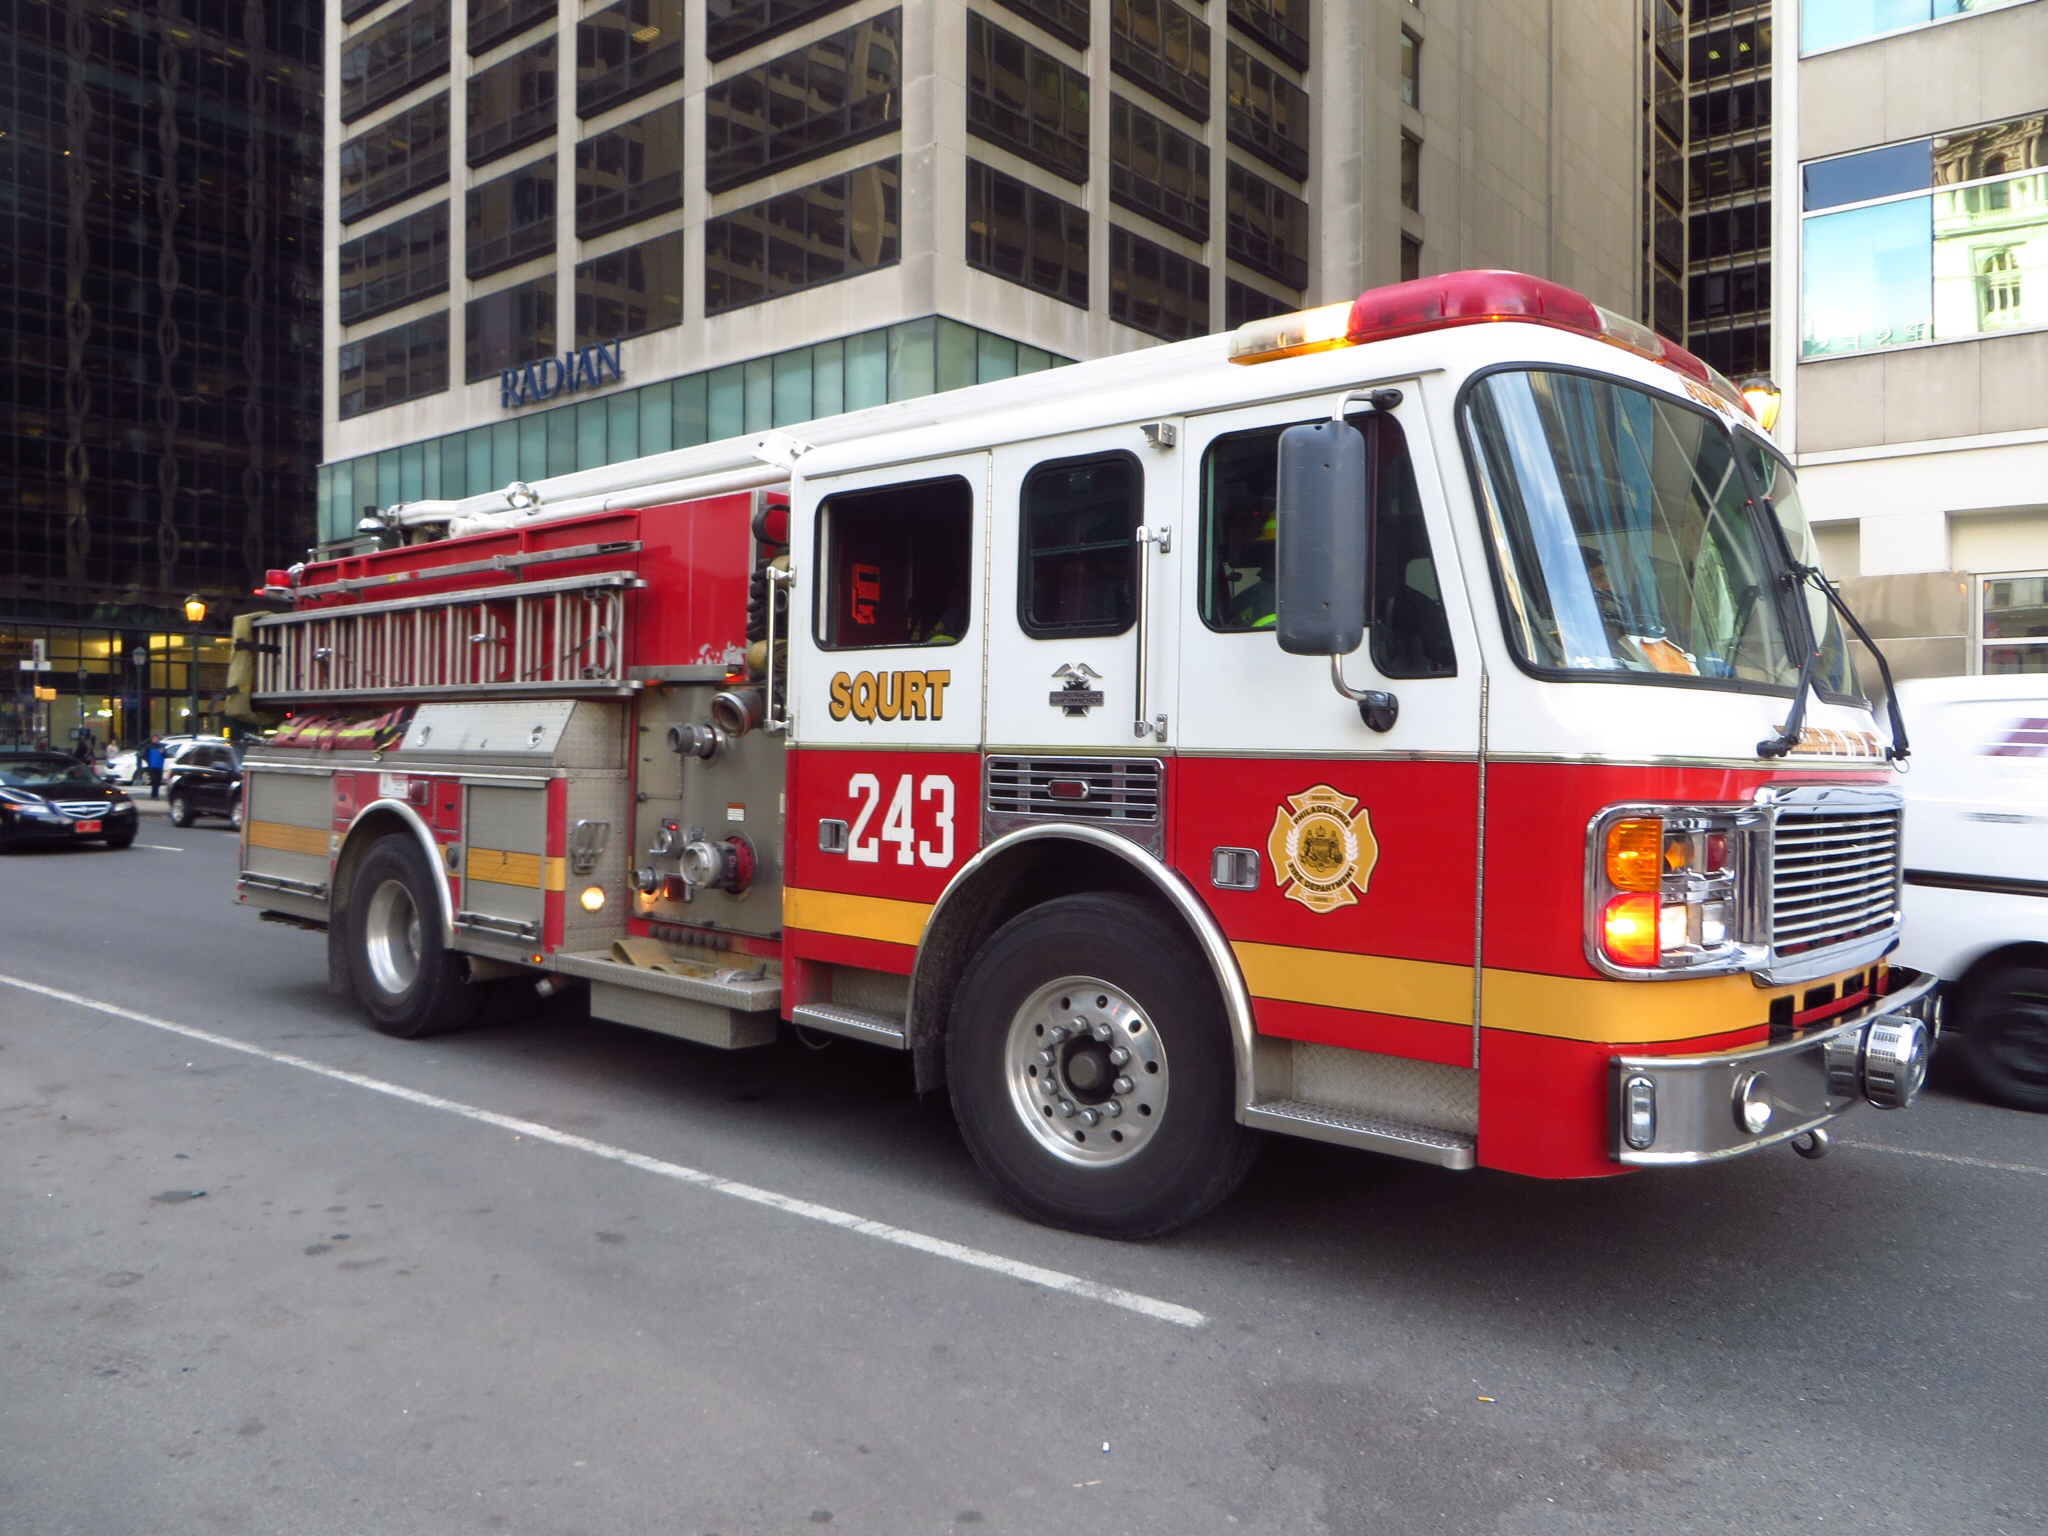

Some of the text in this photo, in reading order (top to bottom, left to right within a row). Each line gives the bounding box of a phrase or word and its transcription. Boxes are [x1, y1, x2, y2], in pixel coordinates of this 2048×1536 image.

[500, 338, 621, 408] RADIAN
[829, 669, 950, 725] SQURT
[848, 773, 955, 868] 243
[1293, 805, 1351, 828] PHILADELPHIA
[1288, 863, 1355, 892] FIRE DEPARTMENT
